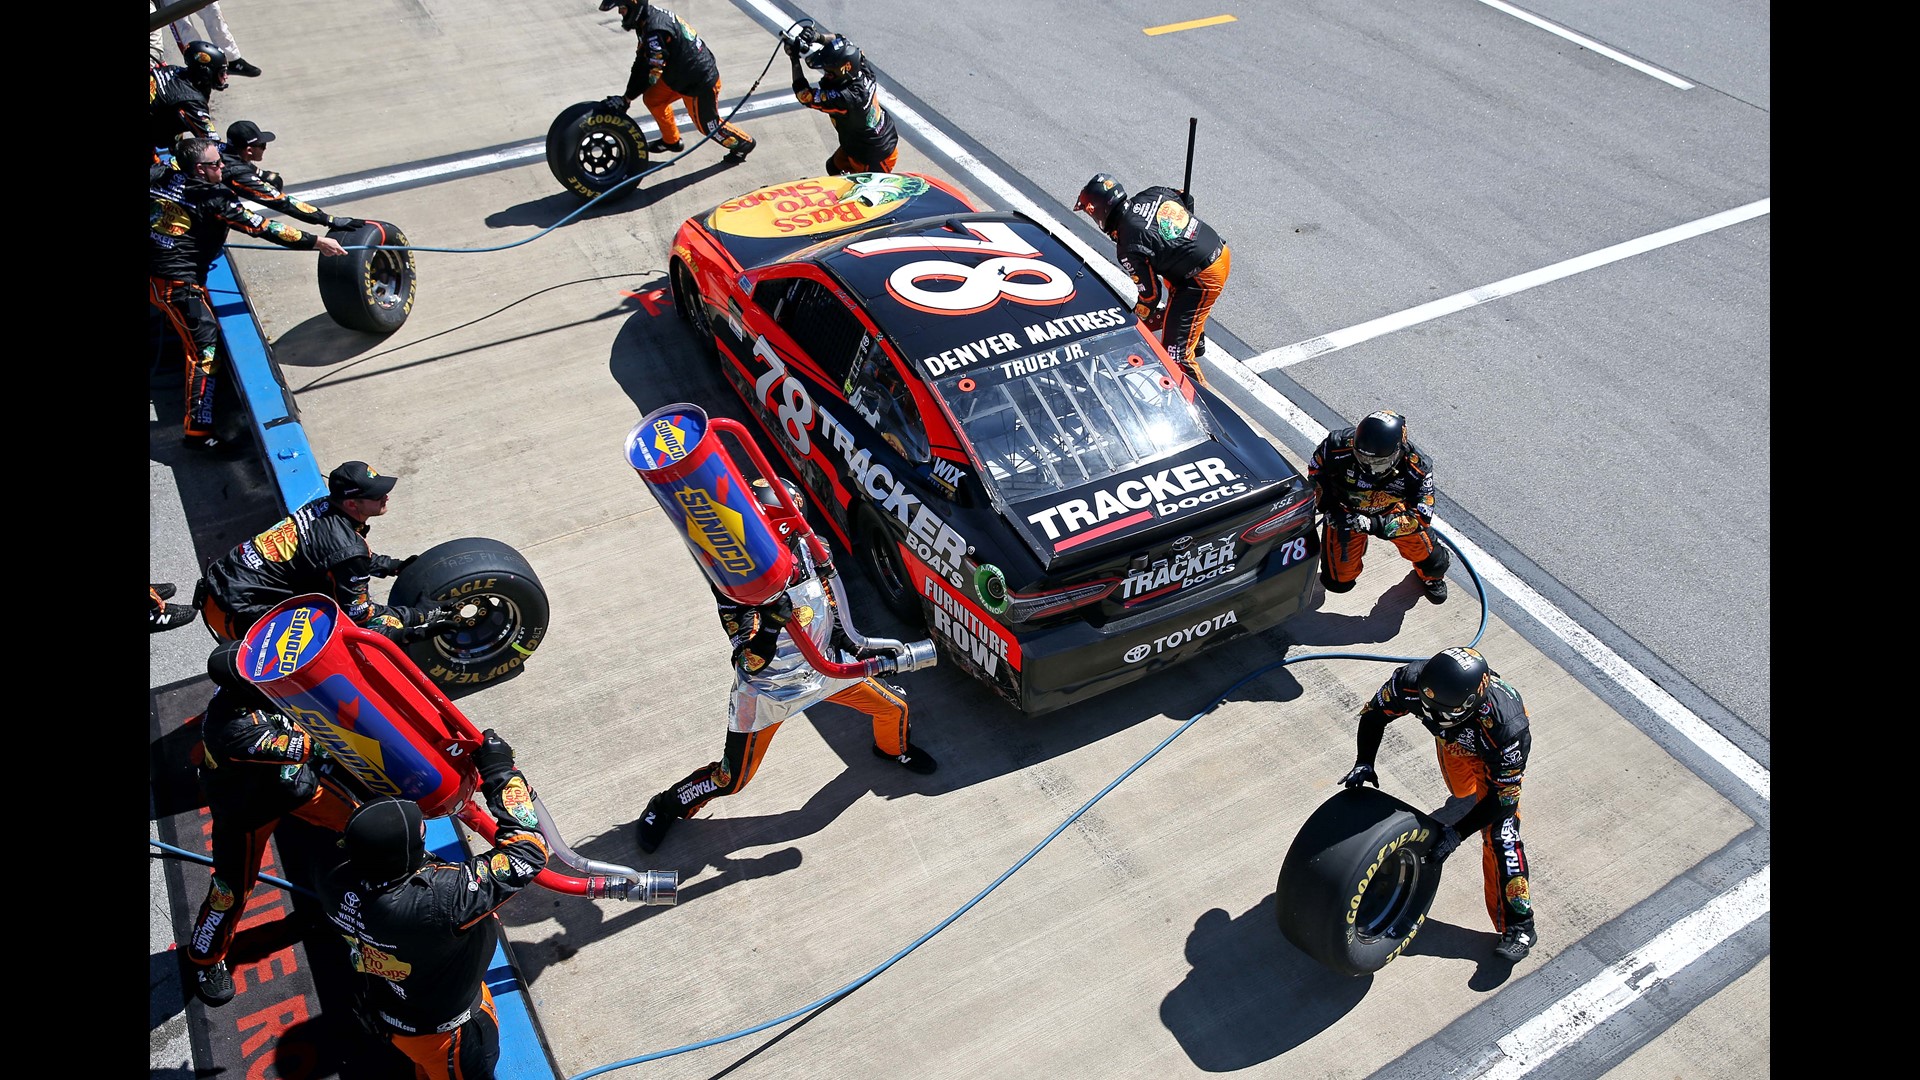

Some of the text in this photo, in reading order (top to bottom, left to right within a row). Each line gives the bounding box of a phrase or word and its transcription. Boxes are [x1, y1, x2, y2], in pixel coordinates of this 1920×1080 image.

[588, 114, 646, 159] GOODYEAR
[720, 180, 824, 213] Shops
[772, 201, 867, 232] Bass
[777, 190, 840, 212] Pro
[362, 260, 374, 306] EAGLE
[841, 222, 1077, 317] 78
[923, 309, 1126, 377] DENVER MATTRESS
[1000, 342, 1090, 380] TRUEX JR.
[752, 334, 815, 455] 78
[656, 420, 685, 460] SUNOCO
[818, 406, 968, 570] TRACKER
[932, 456, 968, 488] WIX
[1157, 481, 1247, 517] boats
[1270, 497, 1294, 513] XSE
[680, 491, 750, 572] SUNOCO
[1280, 538, 1307, 567] 78
[904, 532, 964, 590] BOATS
[1120, 542, 1237, 599] TRACKER
[1182, 563, 1236, 589] boats
[974, 584, 1004, 615] ETHANOL
[980, 564, 1008, 603] AMERICAN
[280, 610, 308, 672] SUNOCO
[924, 576, 1008, 662] FURNITURE
[934, 604, 999, 678] ROW
[1154, 610, 1238, 652] TOYOTA
[680, 778, 718, 805] TRACKER
[1500, 815, 1520, 876] TRACKER
[1346, 828, 1430, 924] GOODYEAR
[195, 910, 224, 954] TRACKER
